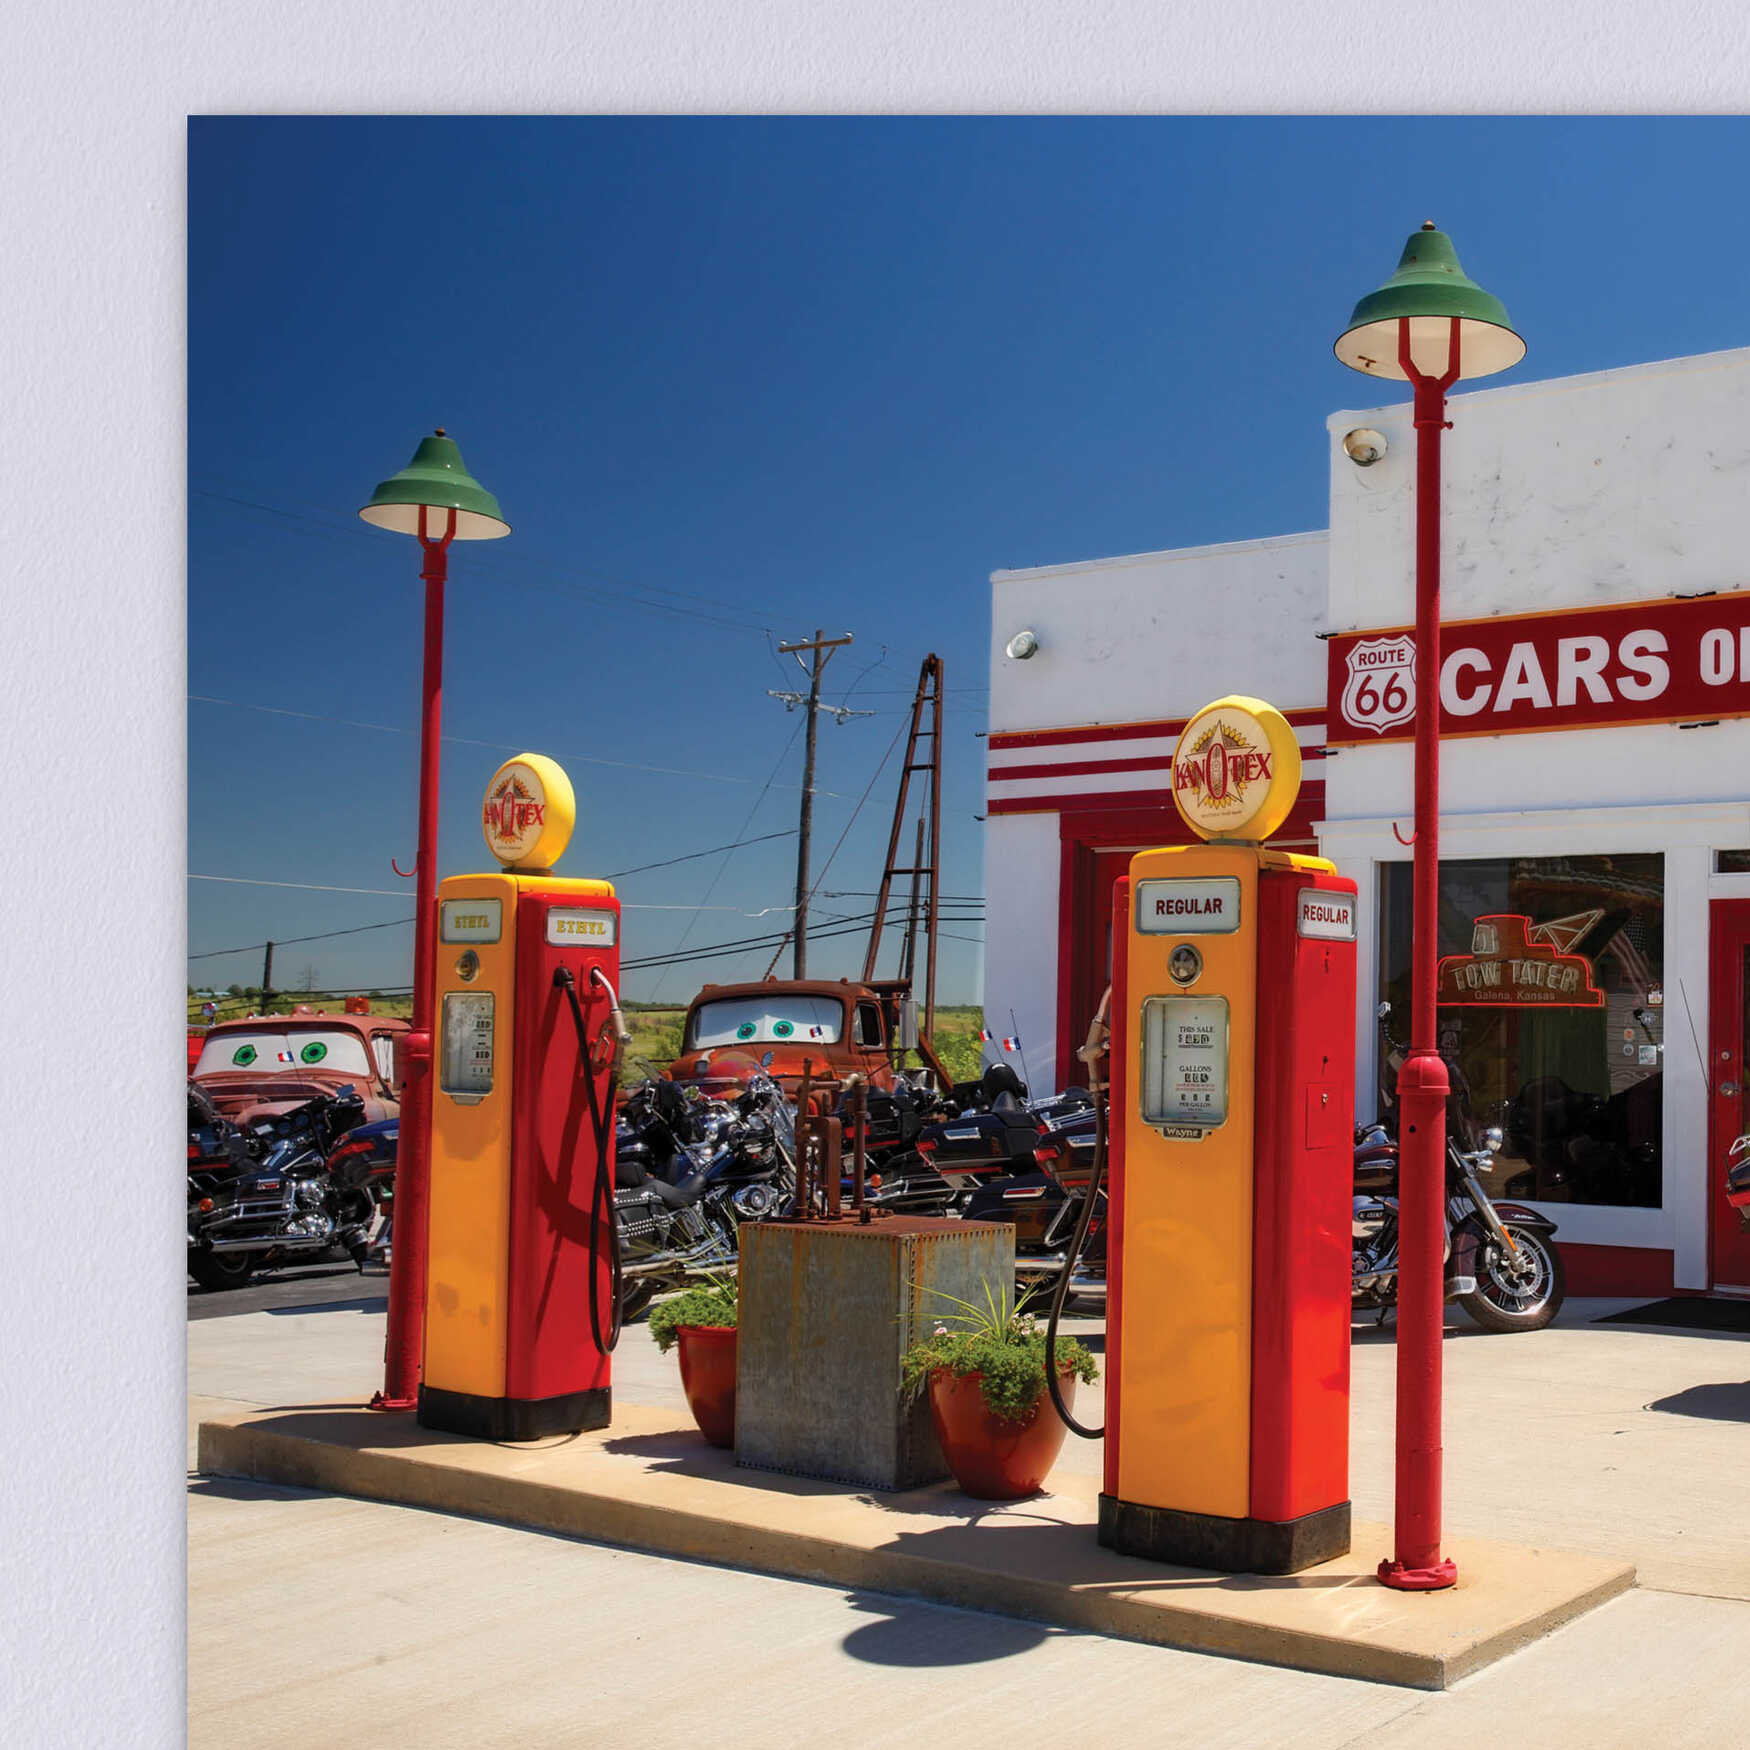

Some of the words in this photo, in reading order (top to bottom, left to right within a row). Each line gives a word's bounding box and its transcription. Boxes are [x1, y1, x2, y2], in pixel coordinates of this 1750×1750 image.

[1357, 648, 1406, 667] ROUTE
[1439, 628, 1670, 717] CARS
[1354, 672, 1408, 716] 66
[1155, 898, 1223, 915] REGULAR
[1303, 904, 1349, 925] REGULAR
[454, 915, 490, 929] ETHYL
[556, 919, 607, 936] ETHYL
[1451, 959, 1501, 992] TOW
[1508, 959, 1580, 995] TATER
[1517, 990, 1556, 1001] Kansas
[1179, 1065, 1212, 1073] GALLONS
[1166, 1128, 1199, 1139] Wayne
